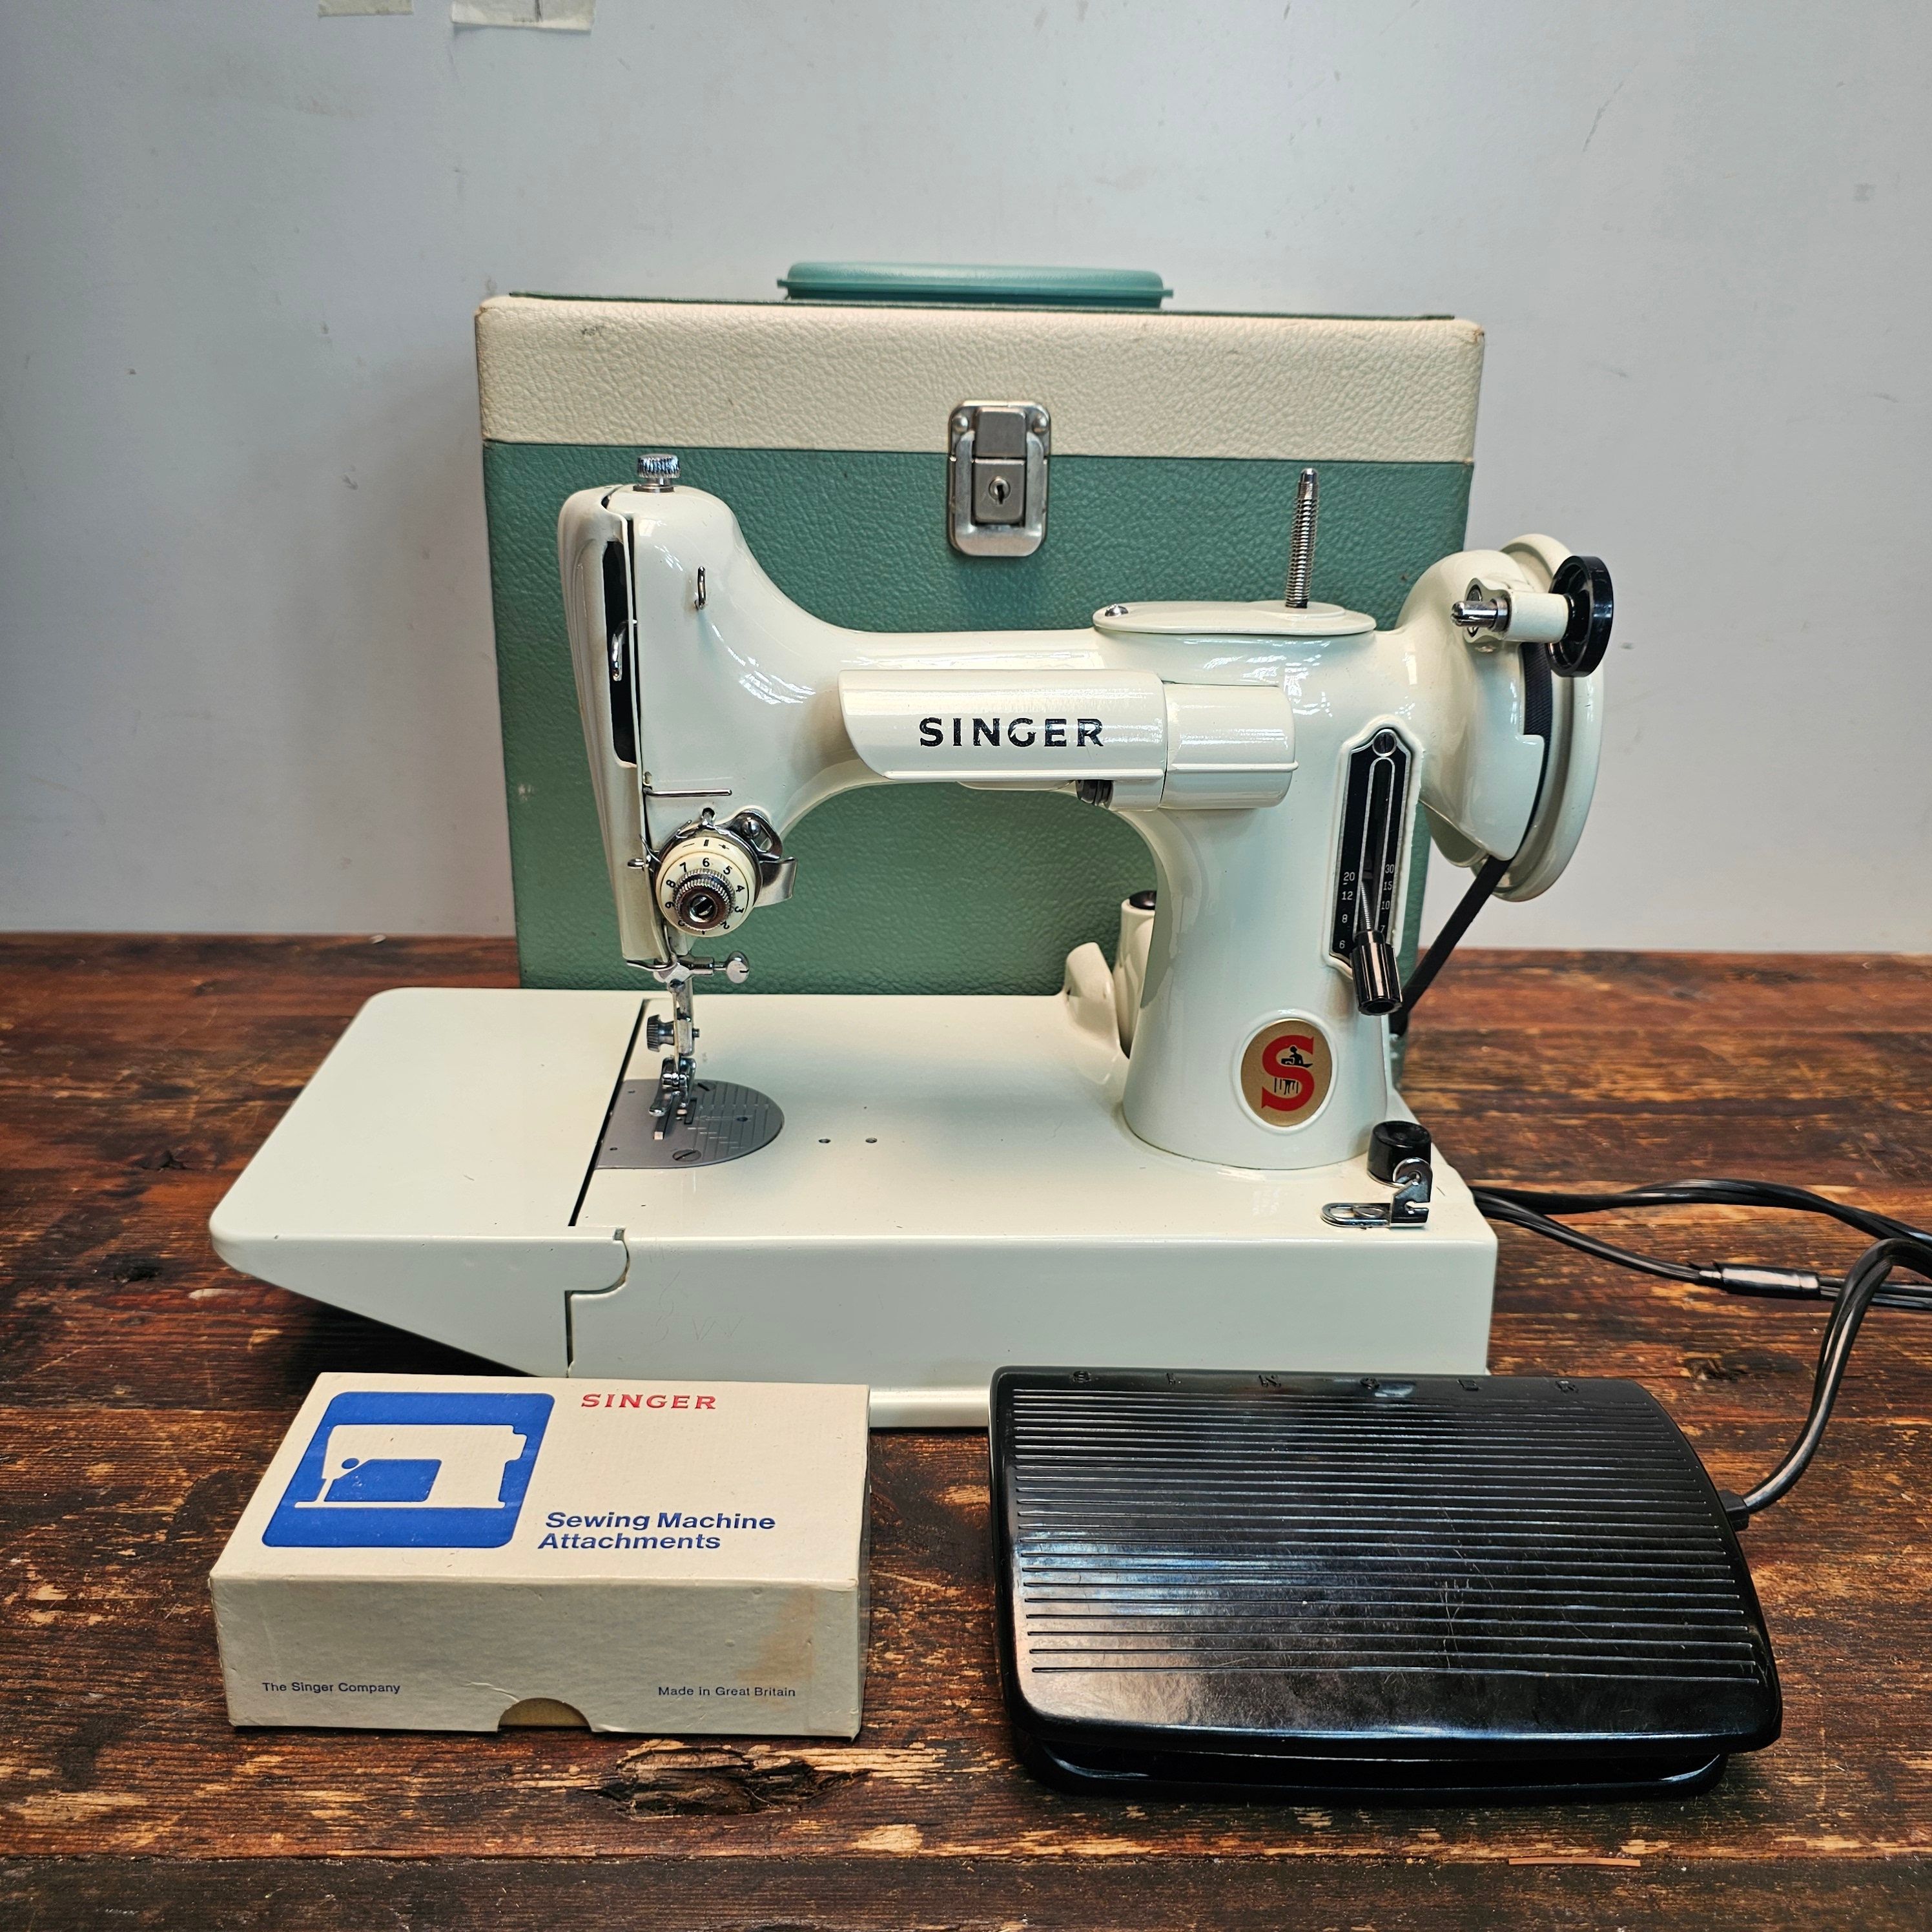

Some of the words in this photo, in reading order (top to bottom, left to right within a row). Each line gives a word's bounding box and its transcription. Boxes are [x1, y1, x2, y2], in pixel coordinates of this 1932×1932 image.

[920, 717, 1104, 748] SINGER
[679, 861, 688, 872] 7
[702, 858, 710, 867] 6
[723, 865, 732, 875] 5
[1385, 863, 1395, 874] 30
[1343, 872, 1355, 881] 20
[666, 879, 675, 888] 8
[1383, 881, 1393, 890] 15
[735, 885, 745, 893] 4
[1341, 890, 1353, 900] 12
[734, 905, 745, 914] 3
[1381, 900, 1390, 910] 10
[1342, 914, 1348, 923] 8
[720, 920, 730, 930] 2
[1380, 925, 1386, 933] 7
[1339, 940, 1345, 949] 6
[1261, 1034, 1315, 1111] S
[581, 1393, 717, 1410] SINGER
[546, 1511, 650, 1531] Sewing
[657, 1512, 776, 1530] Machine
[537, 1532, 721, 1550] Attachments
[262, 1682, 287, 1692] The
[291, 1681, 334, 1694] Singer
[338, 1682, 401, 1694] Company
[658, 1686, 694, 1696] Made
[699, 1687, 710, 1696] in
[715, 1687, 750, 1696] Great
[754, 1687, 796, 1697] Britain
